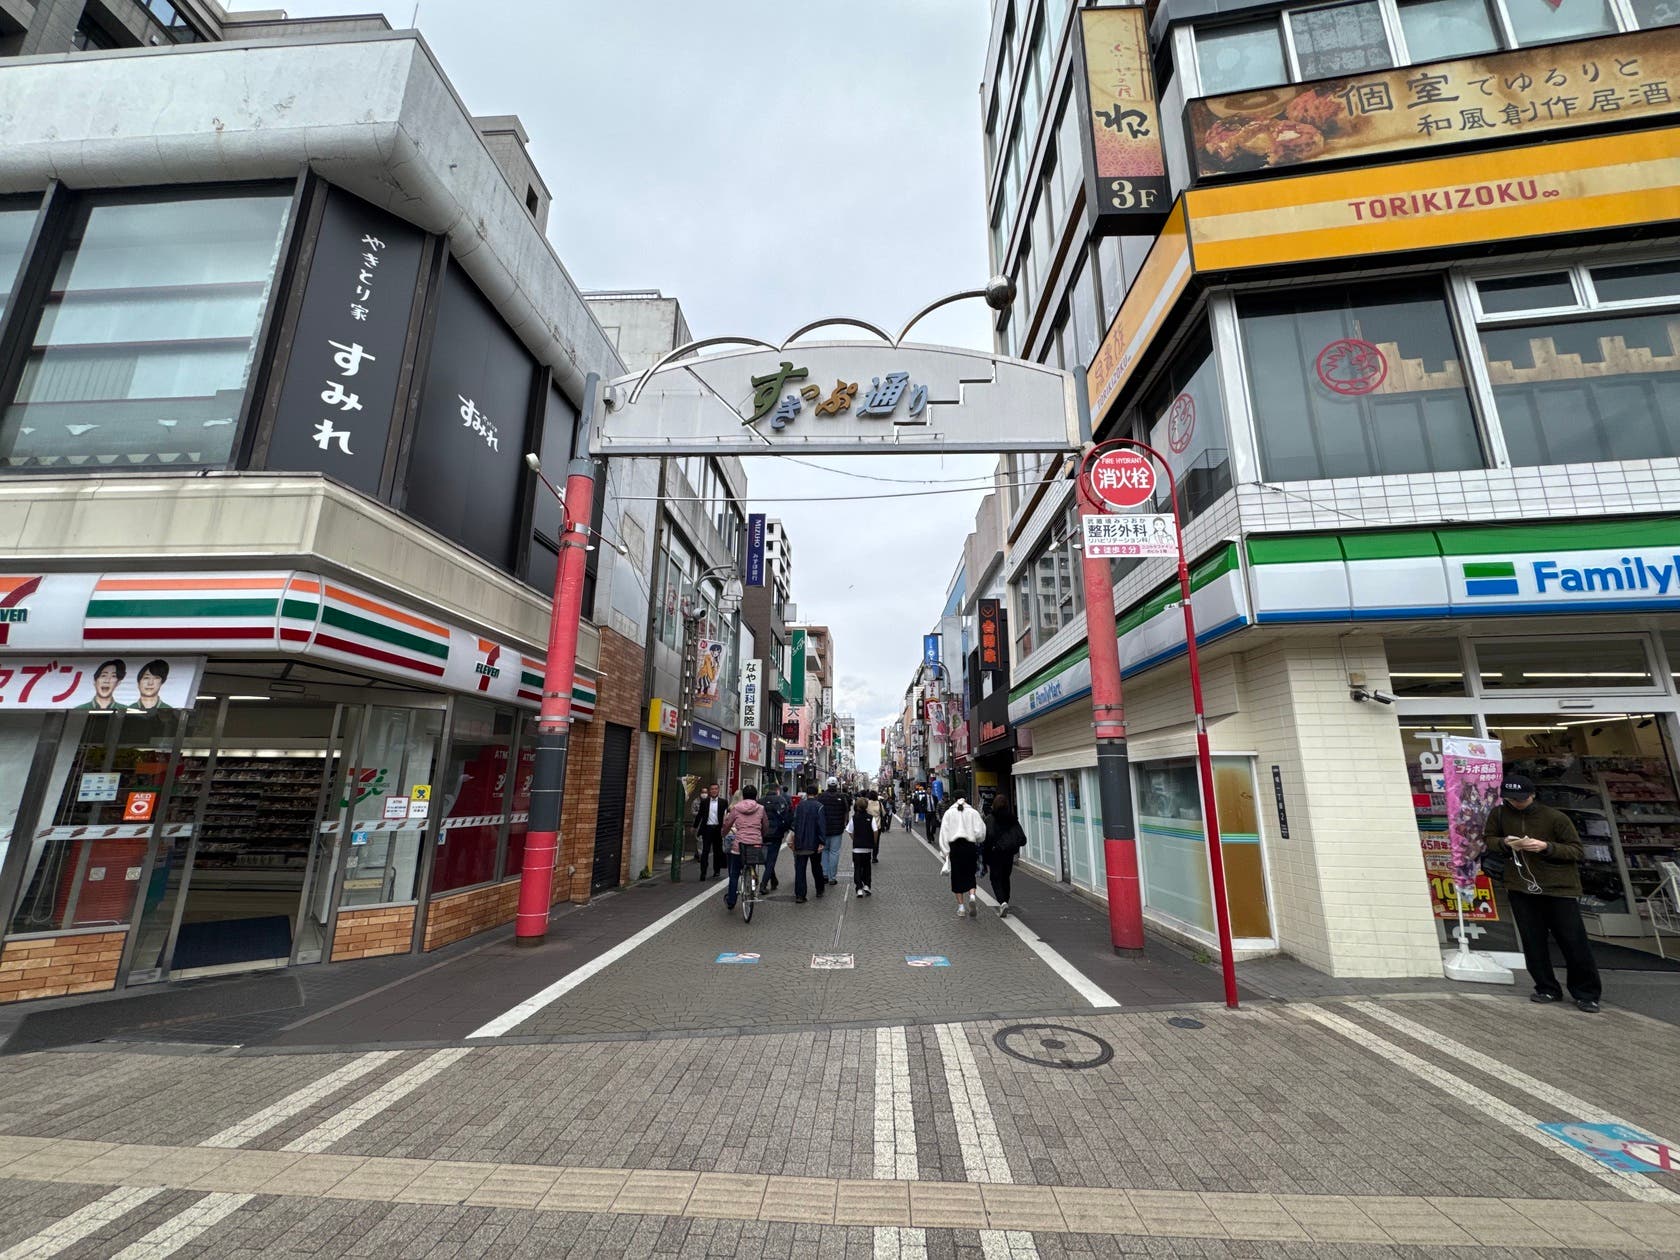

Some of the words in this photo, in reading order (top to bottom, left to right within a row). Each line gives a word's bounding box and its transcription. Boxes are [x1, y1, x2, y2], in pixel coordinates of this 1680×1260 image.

[1336, 56, 1640, 117] 個室でゆるりと
[1416, 80, 1680, 137] 和風創作居酒
[1111, 180, 1158, 209] 3F
[1349, 180, 1539, 221] TORIKIZOKU
[350, 233, 386, 321] やきとり家
[312, 339, 376, 455] すみれ
[742, 361, 930, 431] すきっぷ通り
[458, 394, 498, 453] すみれ
[1098, 467, 1150, 489] 消火栓
[1101, 457, 1114, 465] FIRE
[1115, 457, 1142, 465] HYDRANT
[754, 519, 762, 548] MIZUHO
[1087, 524, 1147, 538] 整形外科
[1532, 555, 1680, 595] Family
[743, 662, 756, 727] なや歯科医院
[1455, 763, 1497, 774] コラボ商品
